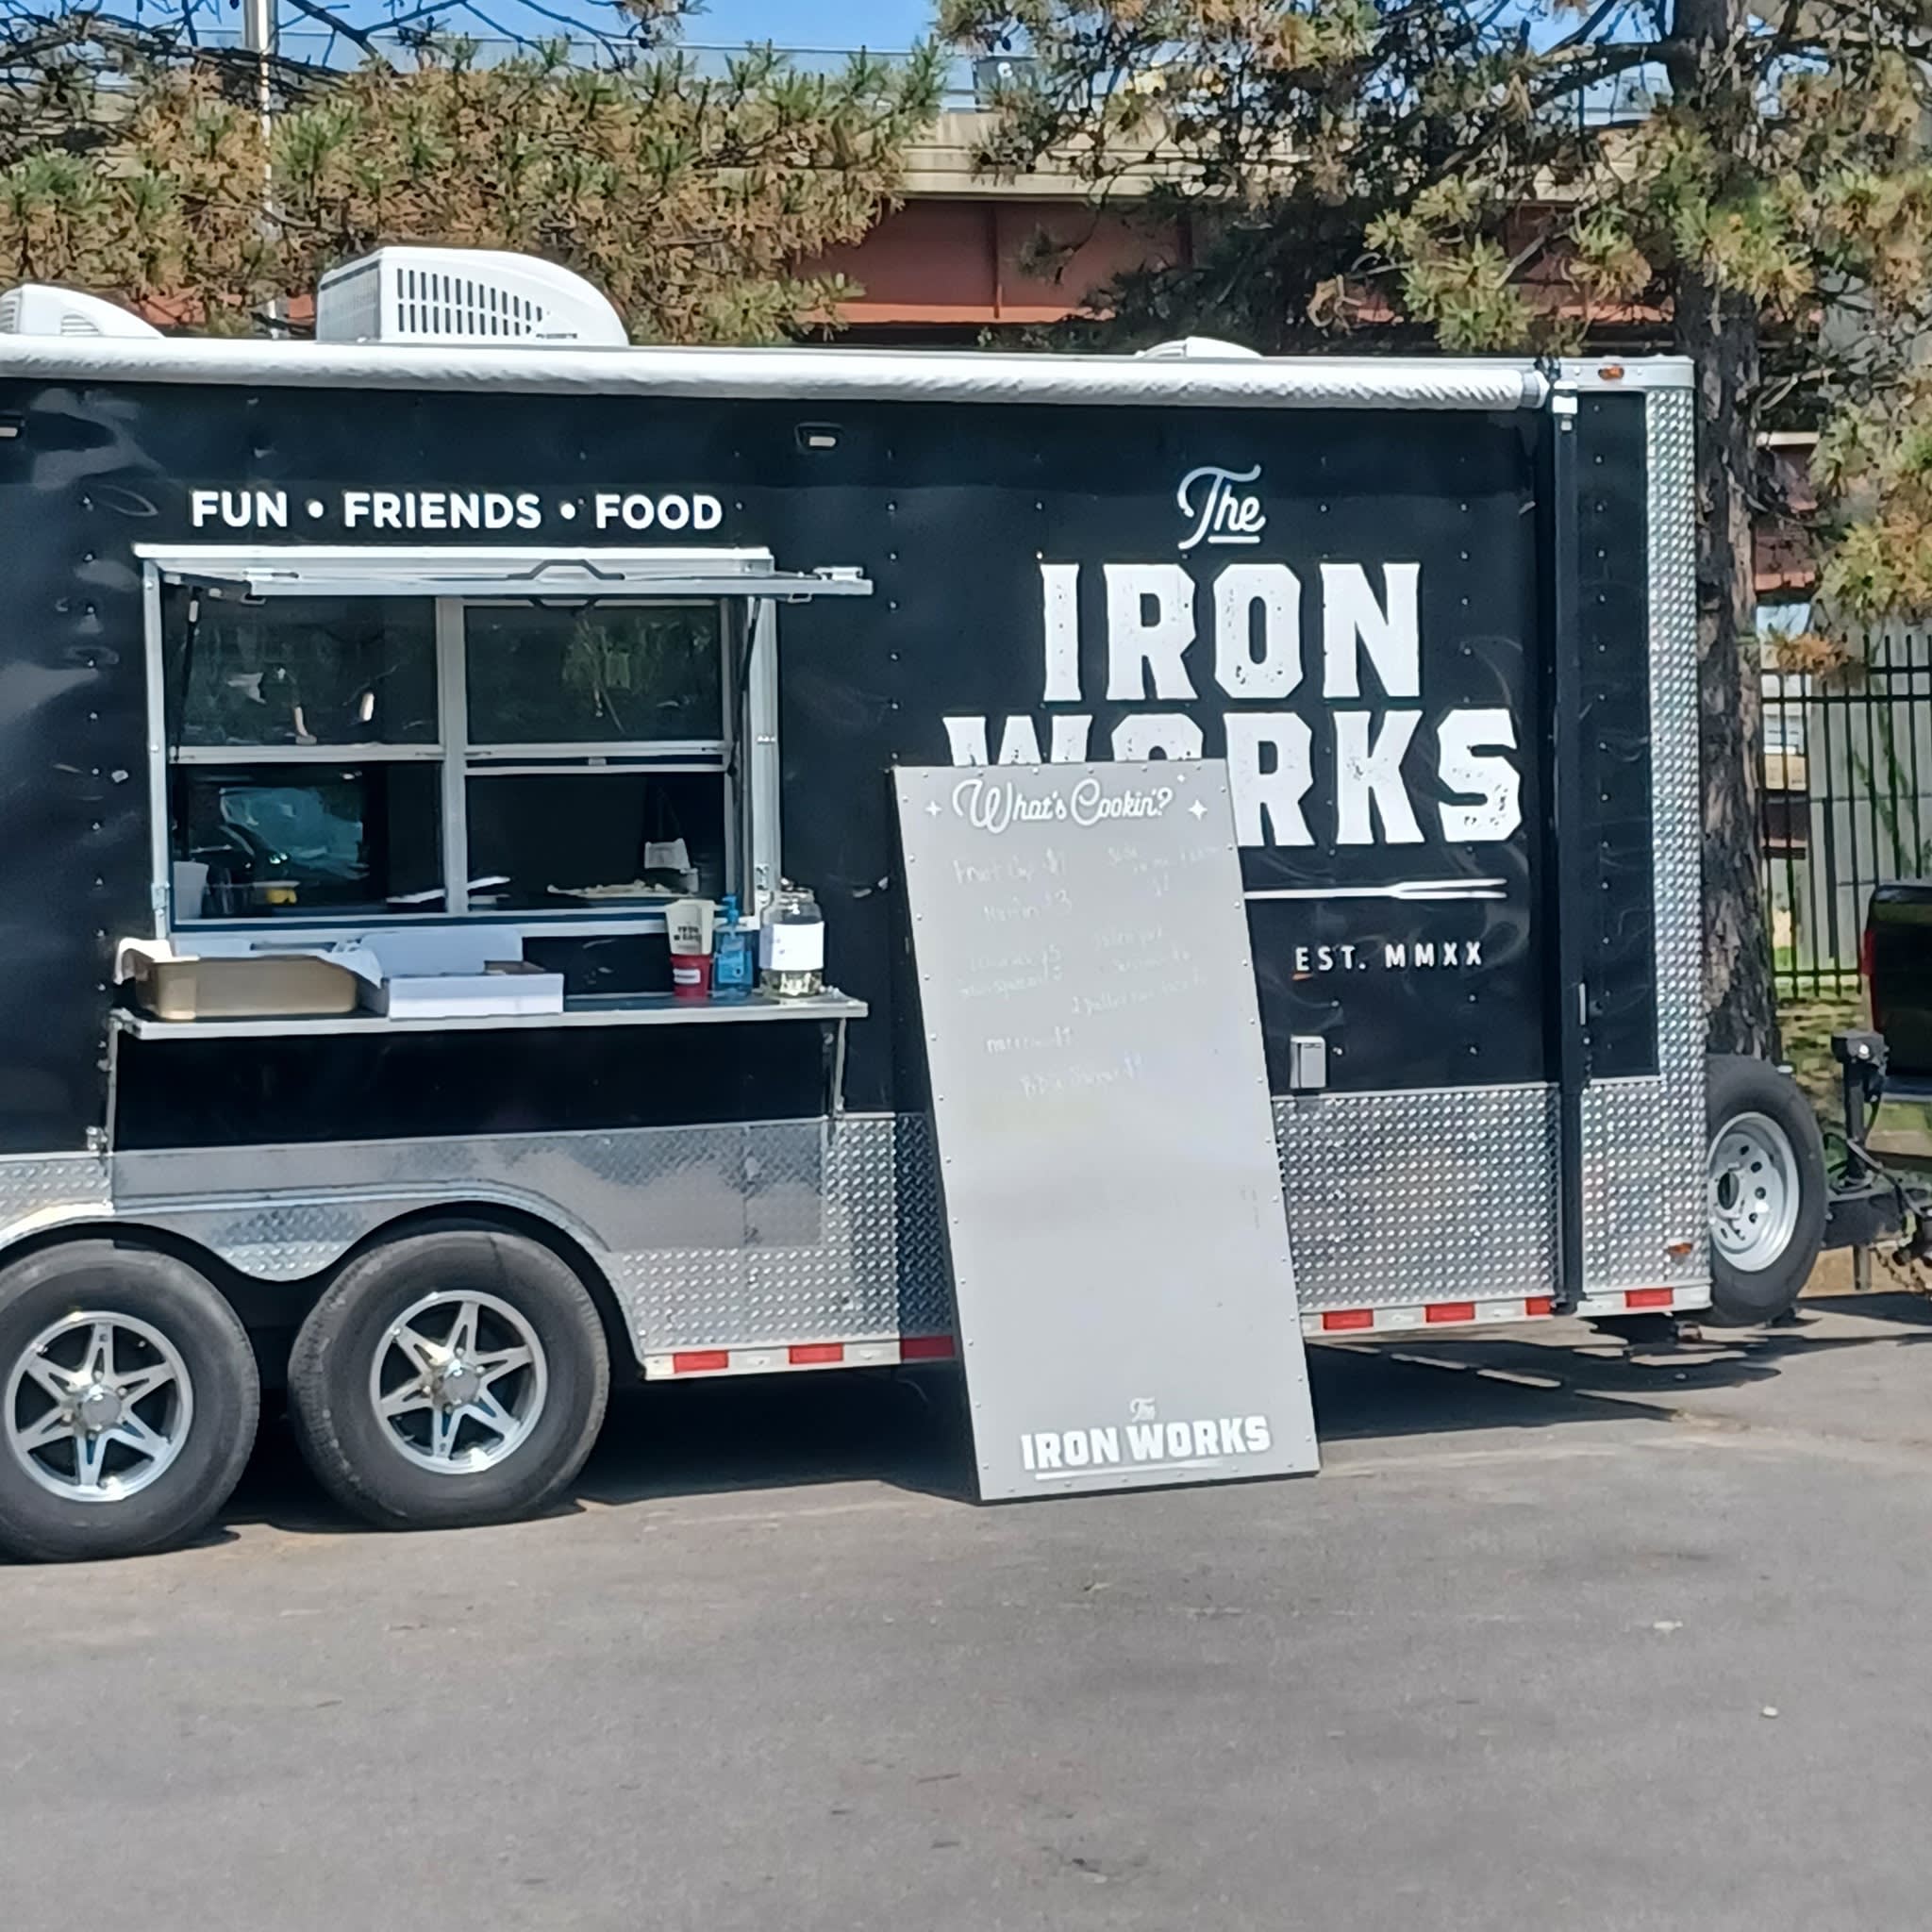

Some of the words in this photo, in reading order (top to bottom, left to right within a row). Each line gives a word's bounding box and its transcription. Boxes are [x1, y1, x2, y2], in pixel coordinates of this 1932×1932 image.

[192, 491, 288, 528] FUN
[343, 491, 541, 530] FRIENDS
[595, 493, 724, 529] FOOD
[1177, 464, 1266, 549] The
[1040, 562, 1422, 702] IRON
[952, 777, 1067, 834] What's
[1071, 777, 1173, 826] Cookin'?
[1294, 945, 1366, 972] EST.
[1384, 941, 1482, 968] MMXX
[1021, 1426, 1120, 1470] IRON
[1125, 1415, 1271, 1461] WORKS
